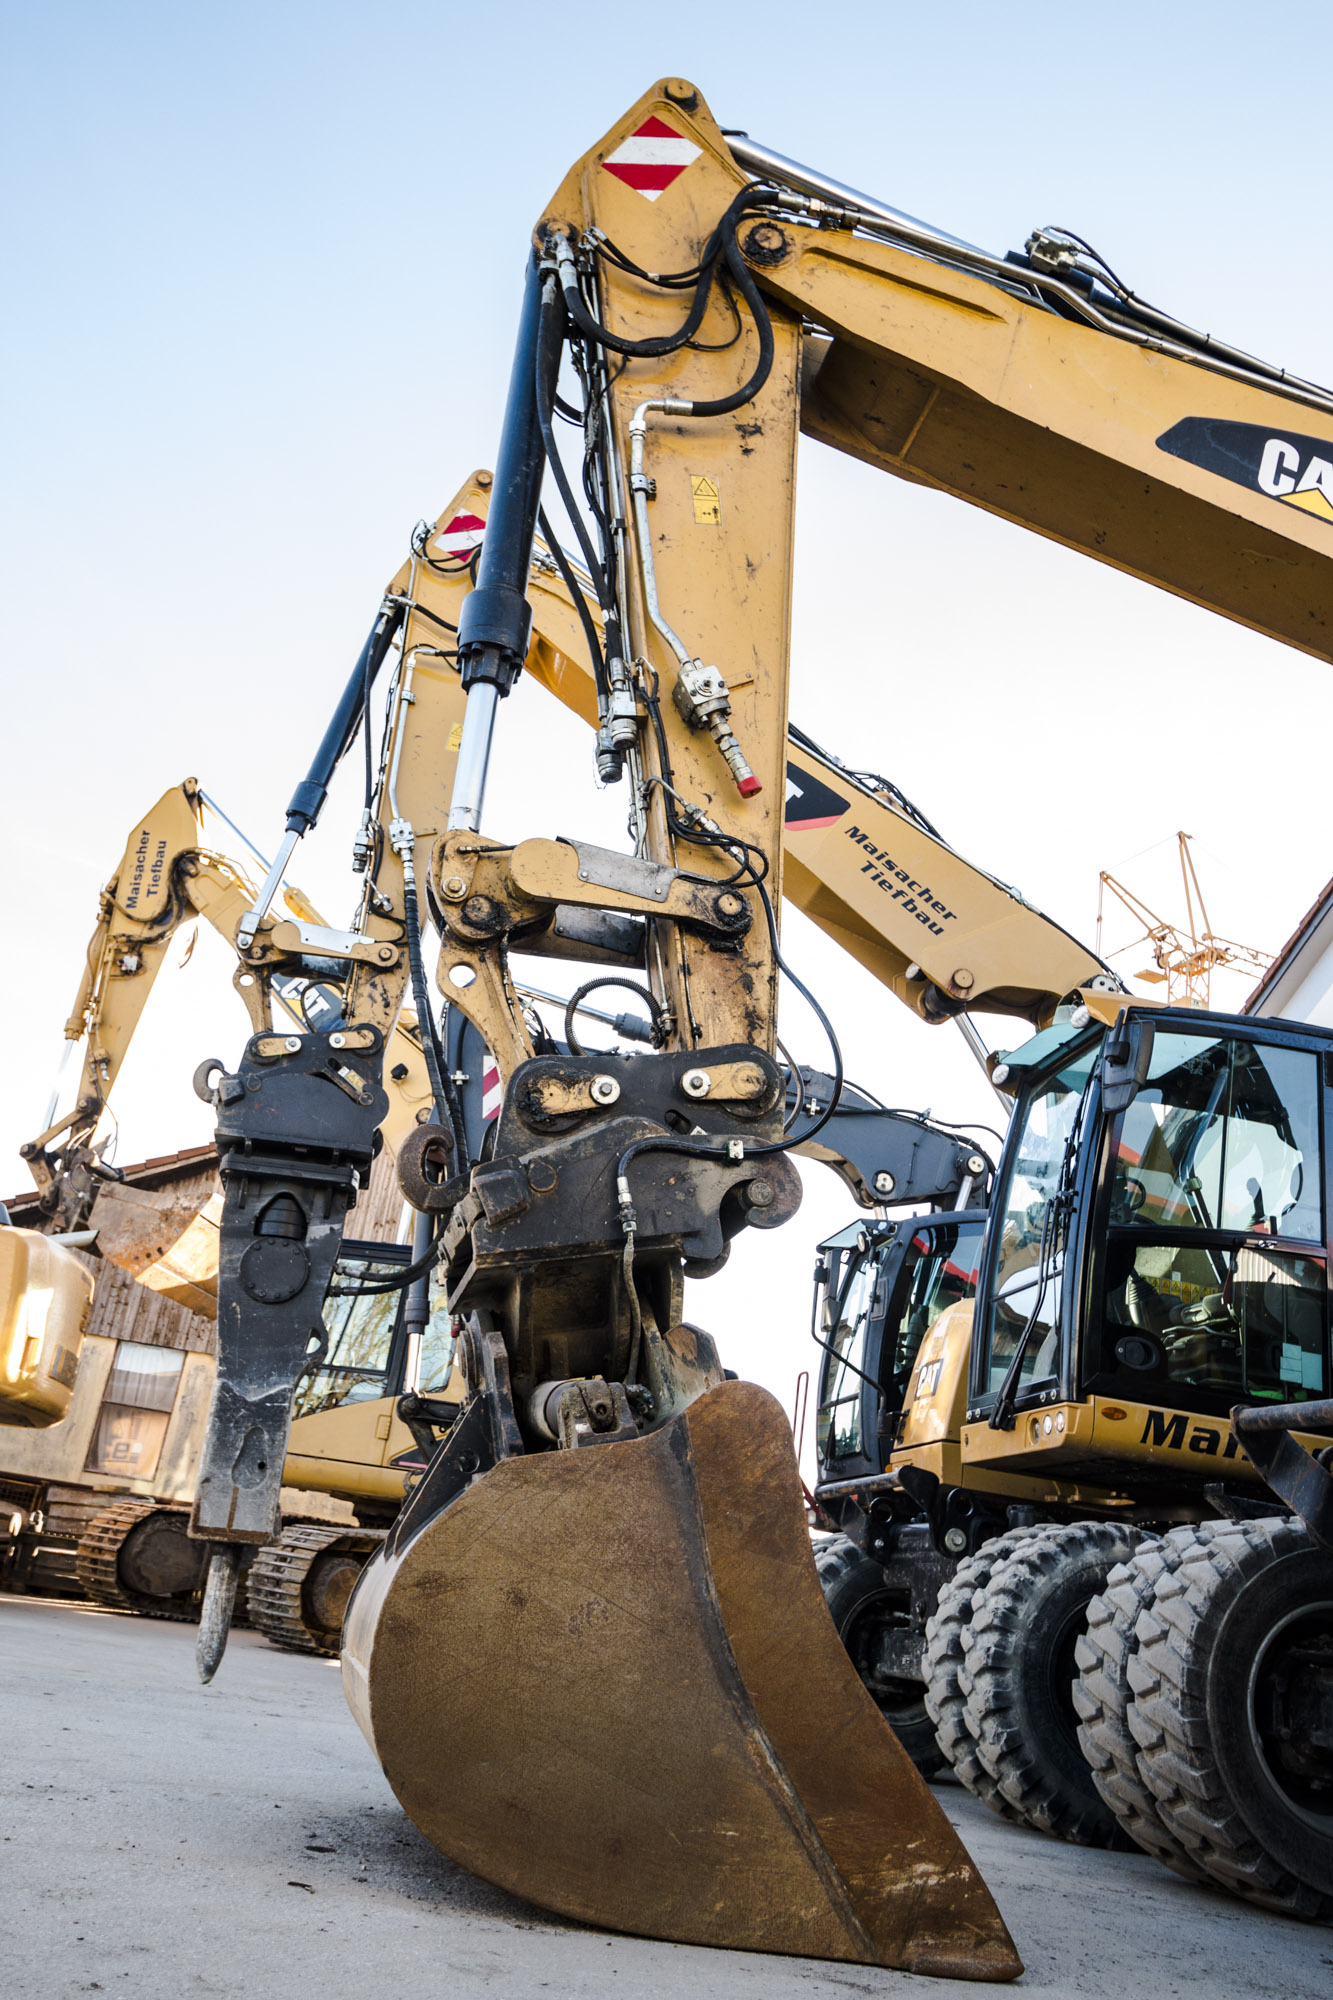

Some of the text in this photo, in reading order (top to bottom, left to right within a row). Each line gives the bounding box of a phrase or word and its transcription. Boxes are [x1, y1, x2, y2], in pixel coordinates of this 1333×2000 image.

[126, 830, 151, 909] Maisacher
[146, 841, 167, 898] Tiefbau
[845, 825, 957, 921] Maisacher
[860, 860, 944, 936] Tiefbau
[281, 977, 331, 1018] CAT
